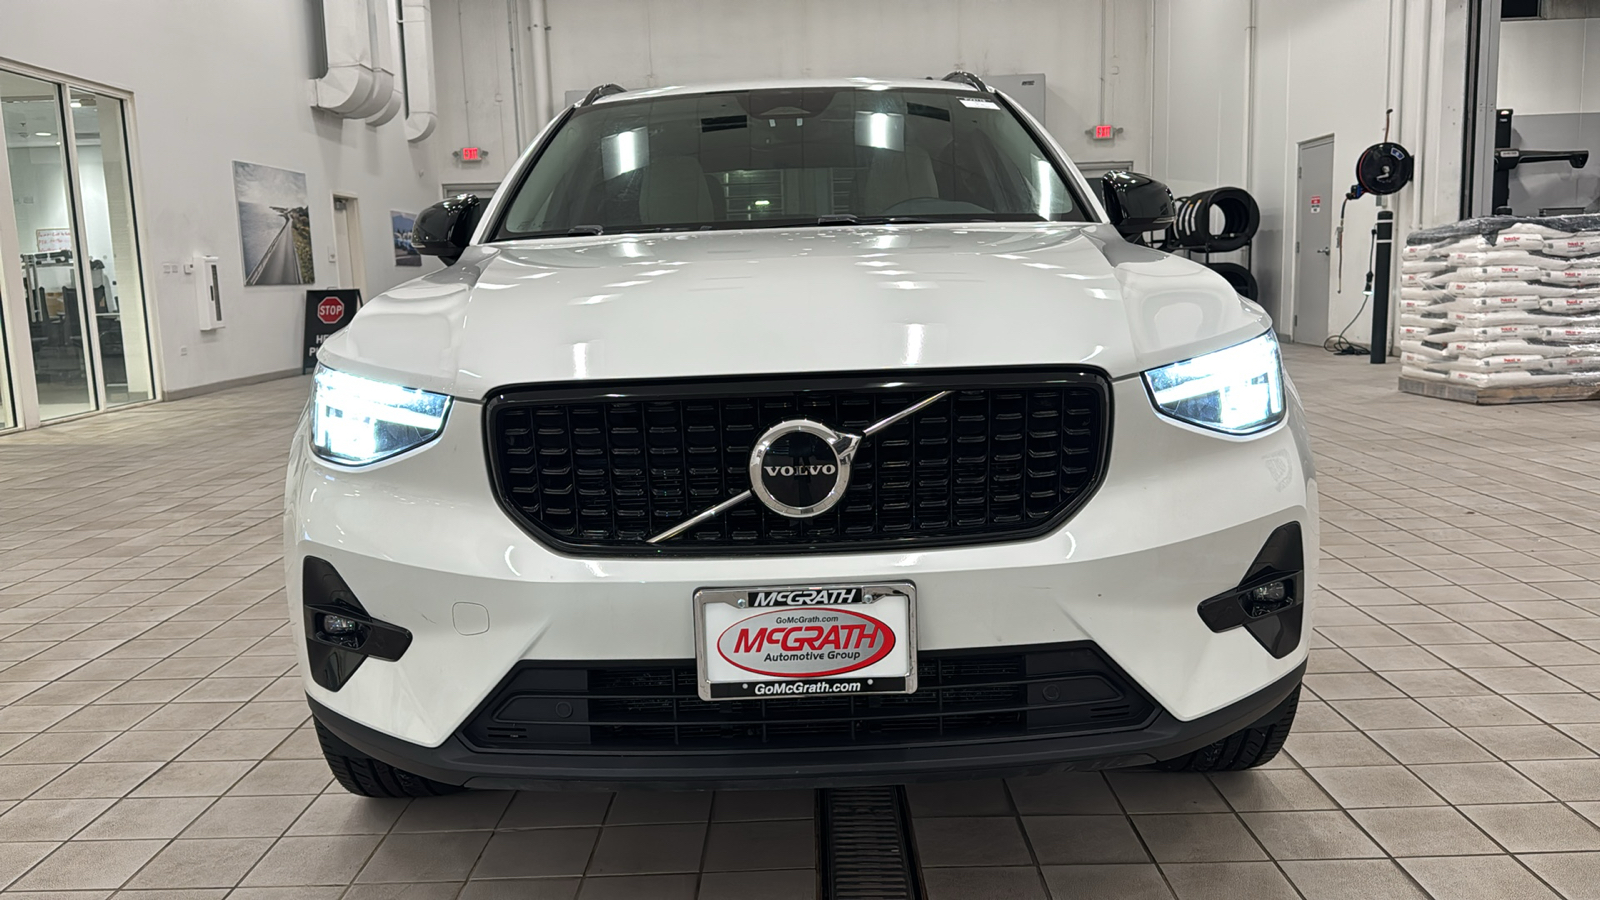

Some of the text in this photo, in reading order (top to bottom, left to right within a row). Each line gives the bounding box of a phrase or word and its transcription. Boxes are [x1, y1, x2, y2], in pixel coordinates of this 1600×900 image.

[320, 306, 342, 316] STOP
[764, 464, 836, 477] VOLVO
[775, 615, 839, 625] GoMcGrath.com
[764, 650, 861, 662] Automotive Group
[754, 681, 862, 695] GoMcGrath.com
